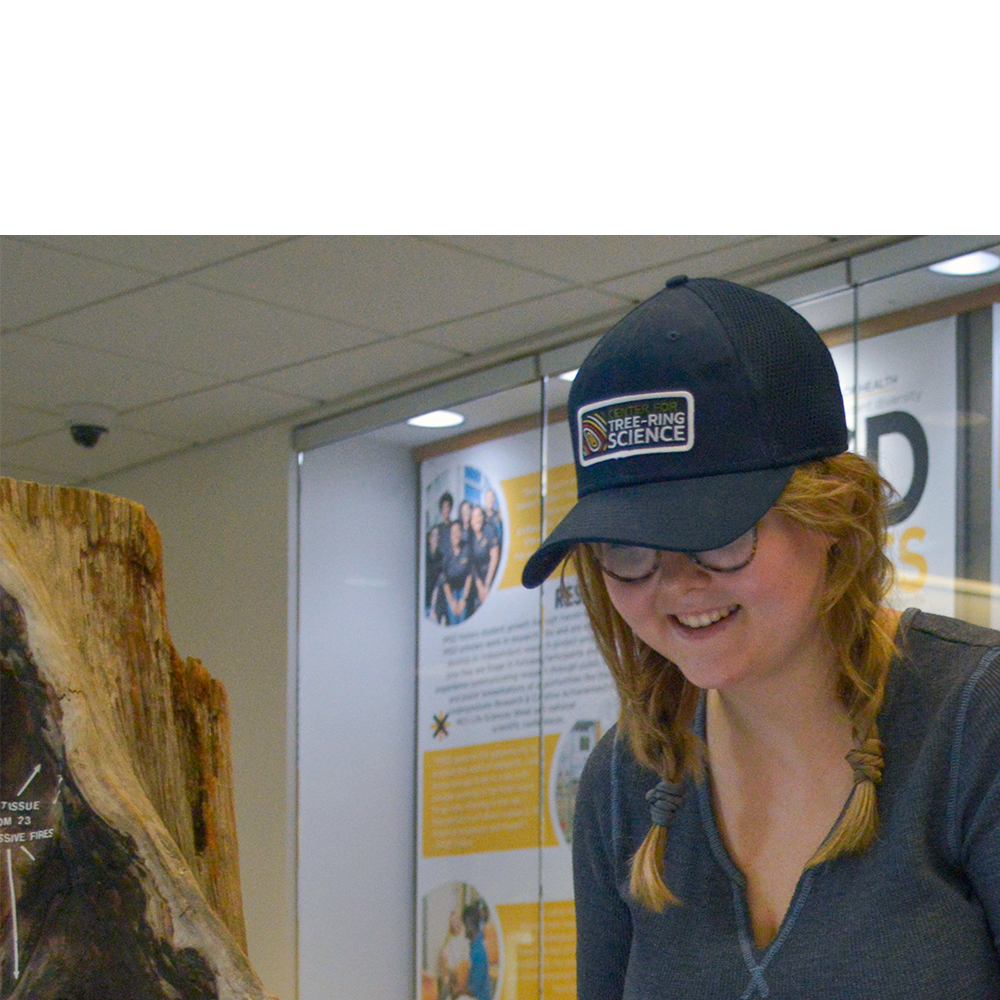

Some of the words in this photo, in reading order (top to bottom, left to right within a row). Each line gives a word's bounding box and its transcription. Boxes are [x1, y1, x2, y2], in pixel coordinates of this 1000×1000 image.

[608, 412, 686, 432] TREE-RING
[608, 425, 686, 449] SCIENCE
[1, 801, 41, 811] TISSUE
[18, 816, 32, 825] 23
[30, 829, 54, 841] FIRES
